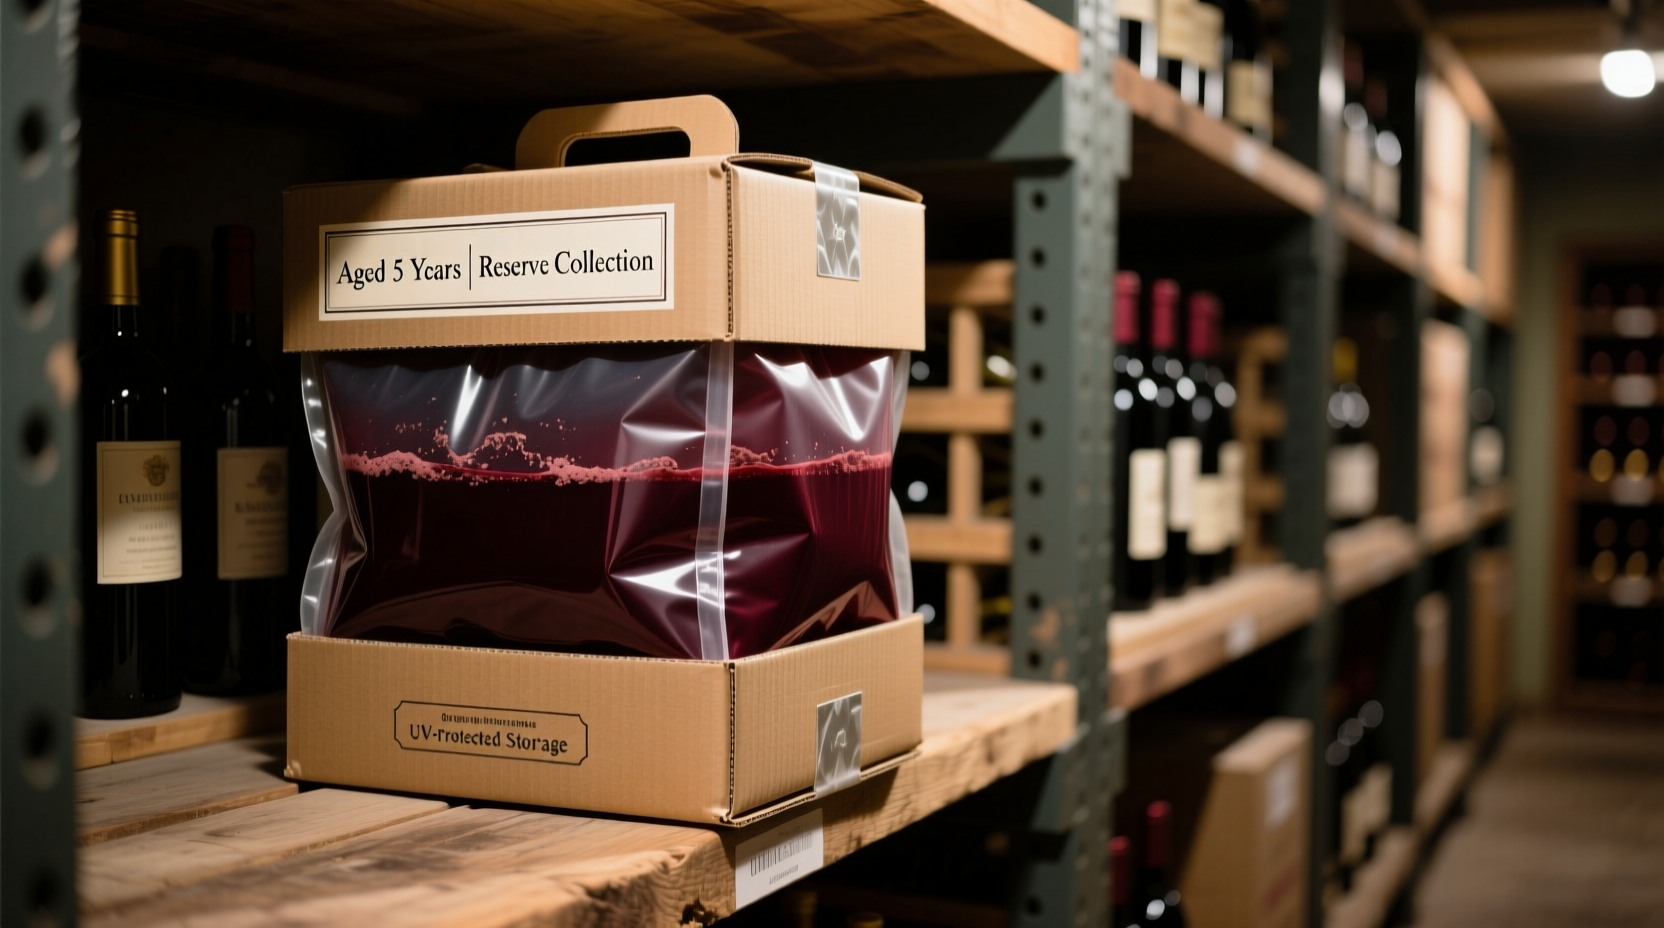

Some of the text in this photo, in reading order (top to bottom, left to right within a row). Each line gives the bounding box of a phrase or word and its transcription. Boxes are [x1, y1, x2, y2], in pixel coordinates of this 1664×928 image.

[336, 258, 386, 291] Aged
[392, 258, 404, 283] 5
[479, 254, 549, 278] Reserve
[554, 248, 655, 275] Collection
[505, 732, 569, 757] Storage
